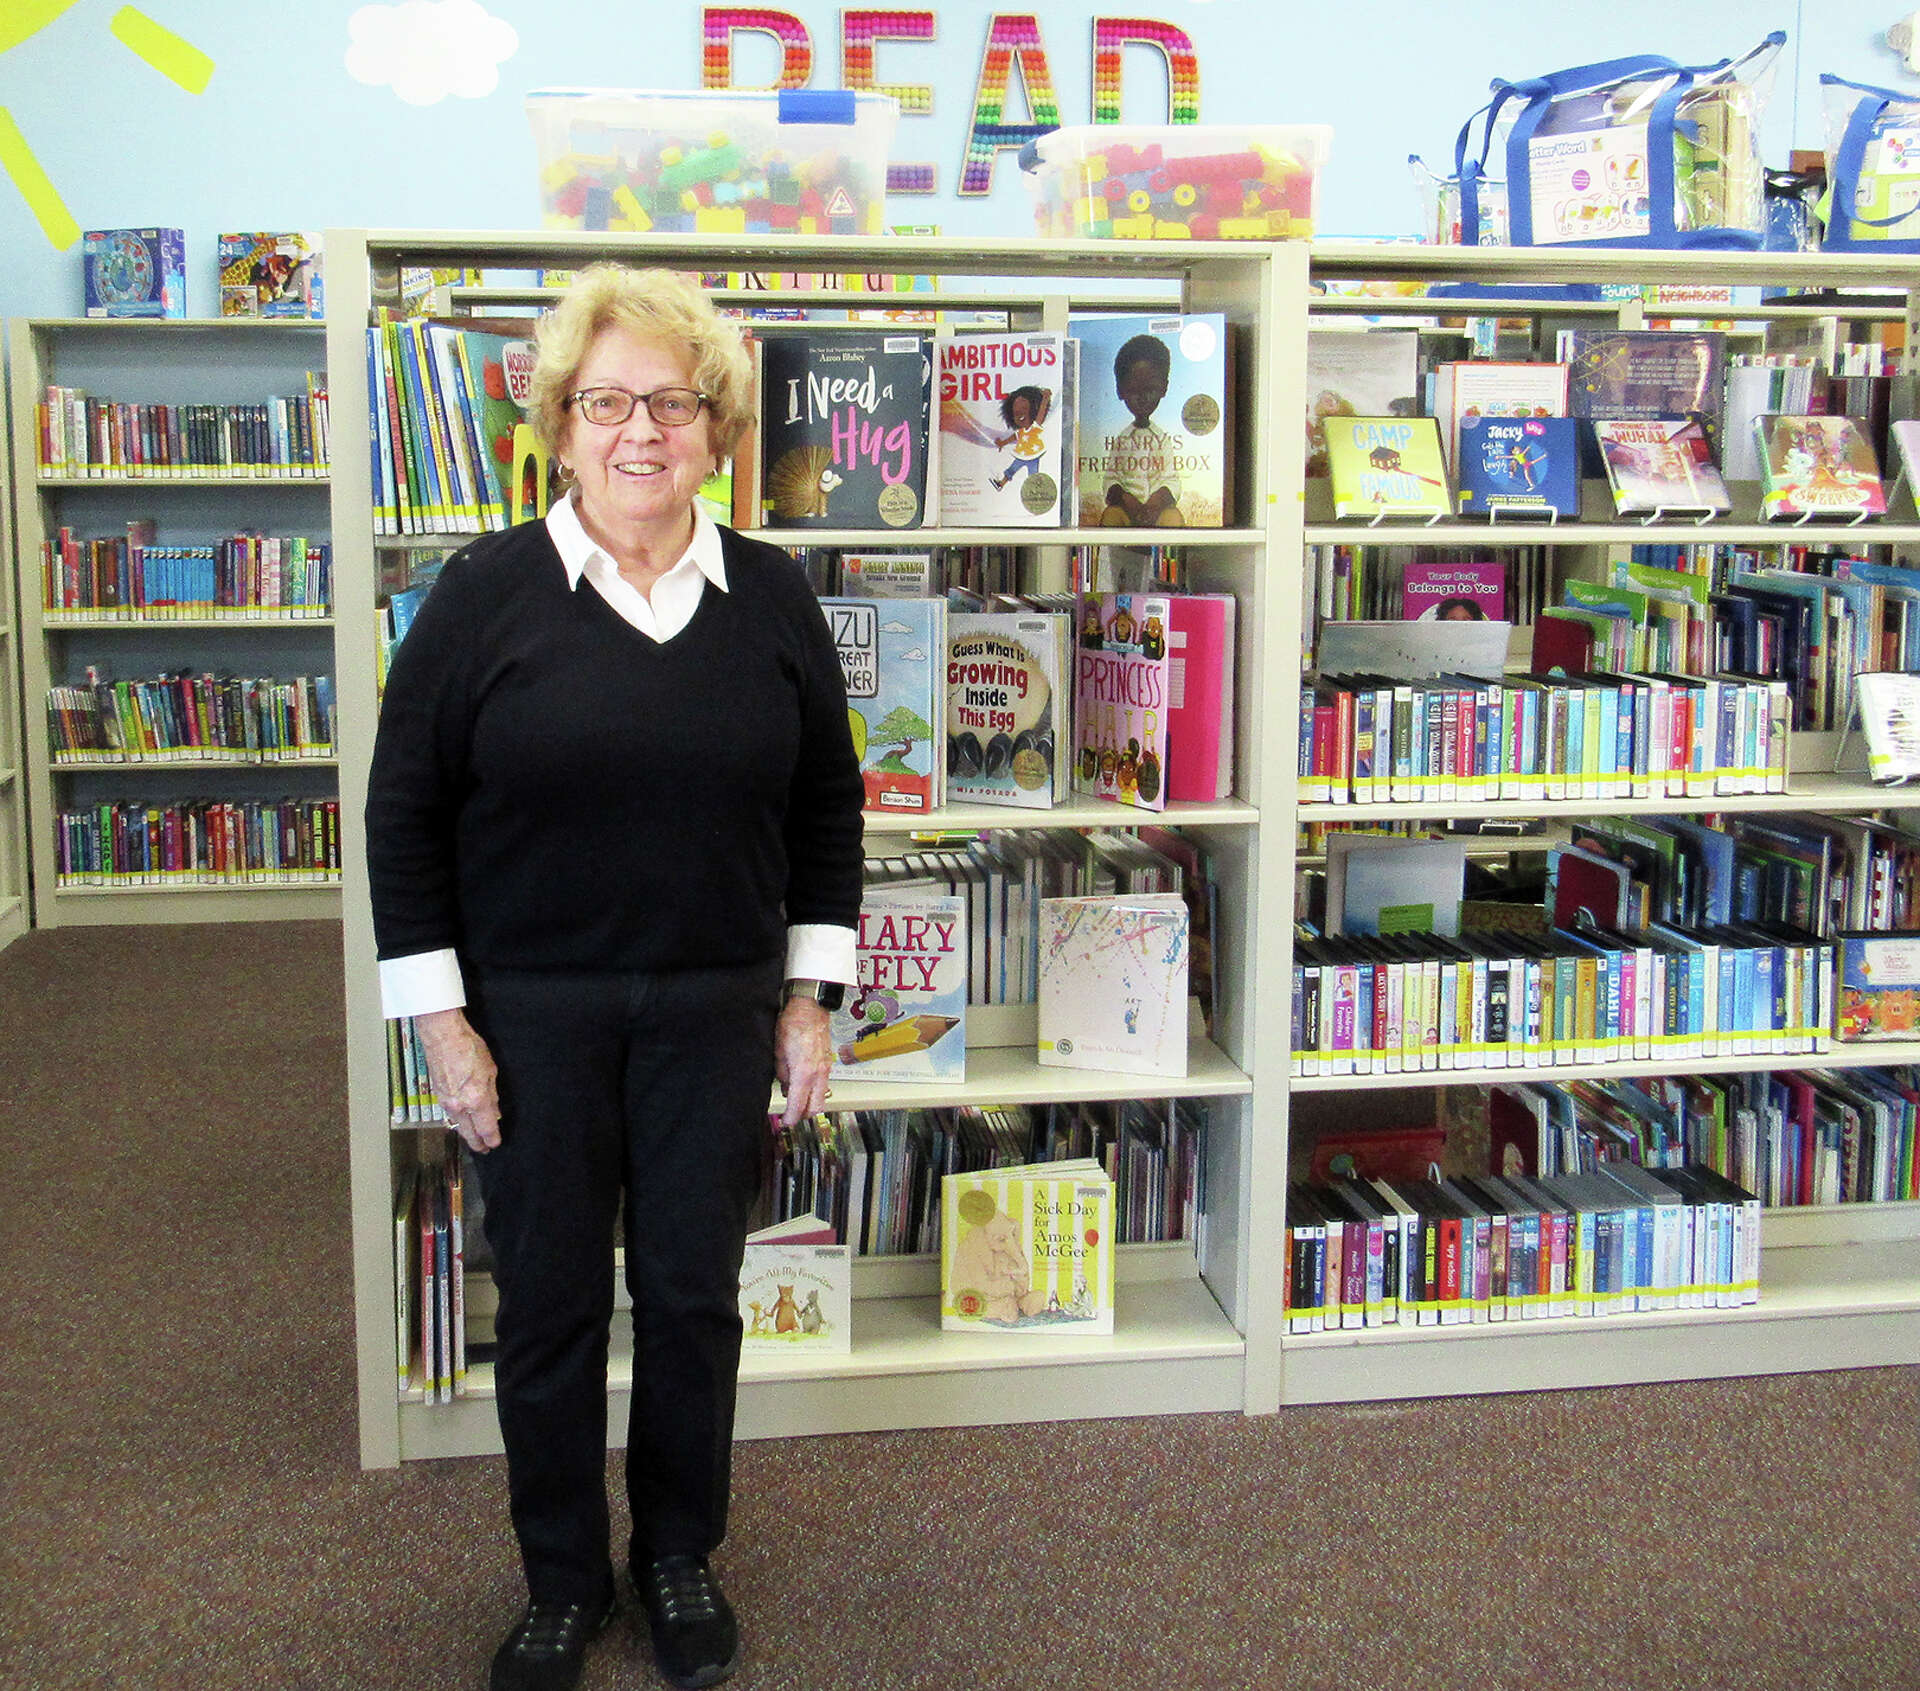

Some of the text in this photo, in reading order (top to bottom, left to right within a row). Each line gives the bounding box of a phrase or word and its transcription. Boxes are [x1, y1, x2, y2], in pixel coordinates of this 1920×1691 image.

[702, 7, 1203, 197] READ
[1529, 140, 1587, 159] etter Word
[403, 271, 431, 286] NKING
[940, 341, 1057, 369] AMBITIOUS
[785, 366, 893, 425] I Need a
[940, 373, 1010, 401] GIRL
[832, 406, 911, 486] Hug
[1104, 433, 1184, 452] HENRY'S
[1352, 424, 1415, 450] CAMP
[1078, 455, 1211, 473] FREEDOM BOX
[1360, 473, 1424, 501] FAMOUS
[1407, 582, 1499, 595] Belongs to You
[838, 651, 872, 668] REAT
[952, 641, 1026, 662] Guess What Is
[947, 660, 1028, 699] Growing
[1079, 655, 1162, 710] PRINCESS
[965, 687, 1008, 707] Inside
[958, 706, 1015, 733] This Egg
[957, 786, 974, 794] MIA
[856, 914, 956, 952] IARY
[869, 954, 942, 991] FLY
[1608, 974, 1621, 1021] DAHL
[1337, 1006, 1346, 1037] Favorites
[1345, 1006, 1354, 1040] Children's
[1035, 1188, 1046, 1201] A
[1034, 1200, 1097, 1220] Sick Day
[1034, 1215, 1049, 1228] for
[1034, 1229, 1078, 1242] Amos
[1034, 1243, 1089, 1258] McGee
[1447, 1244, 1457, 1288] spy school
